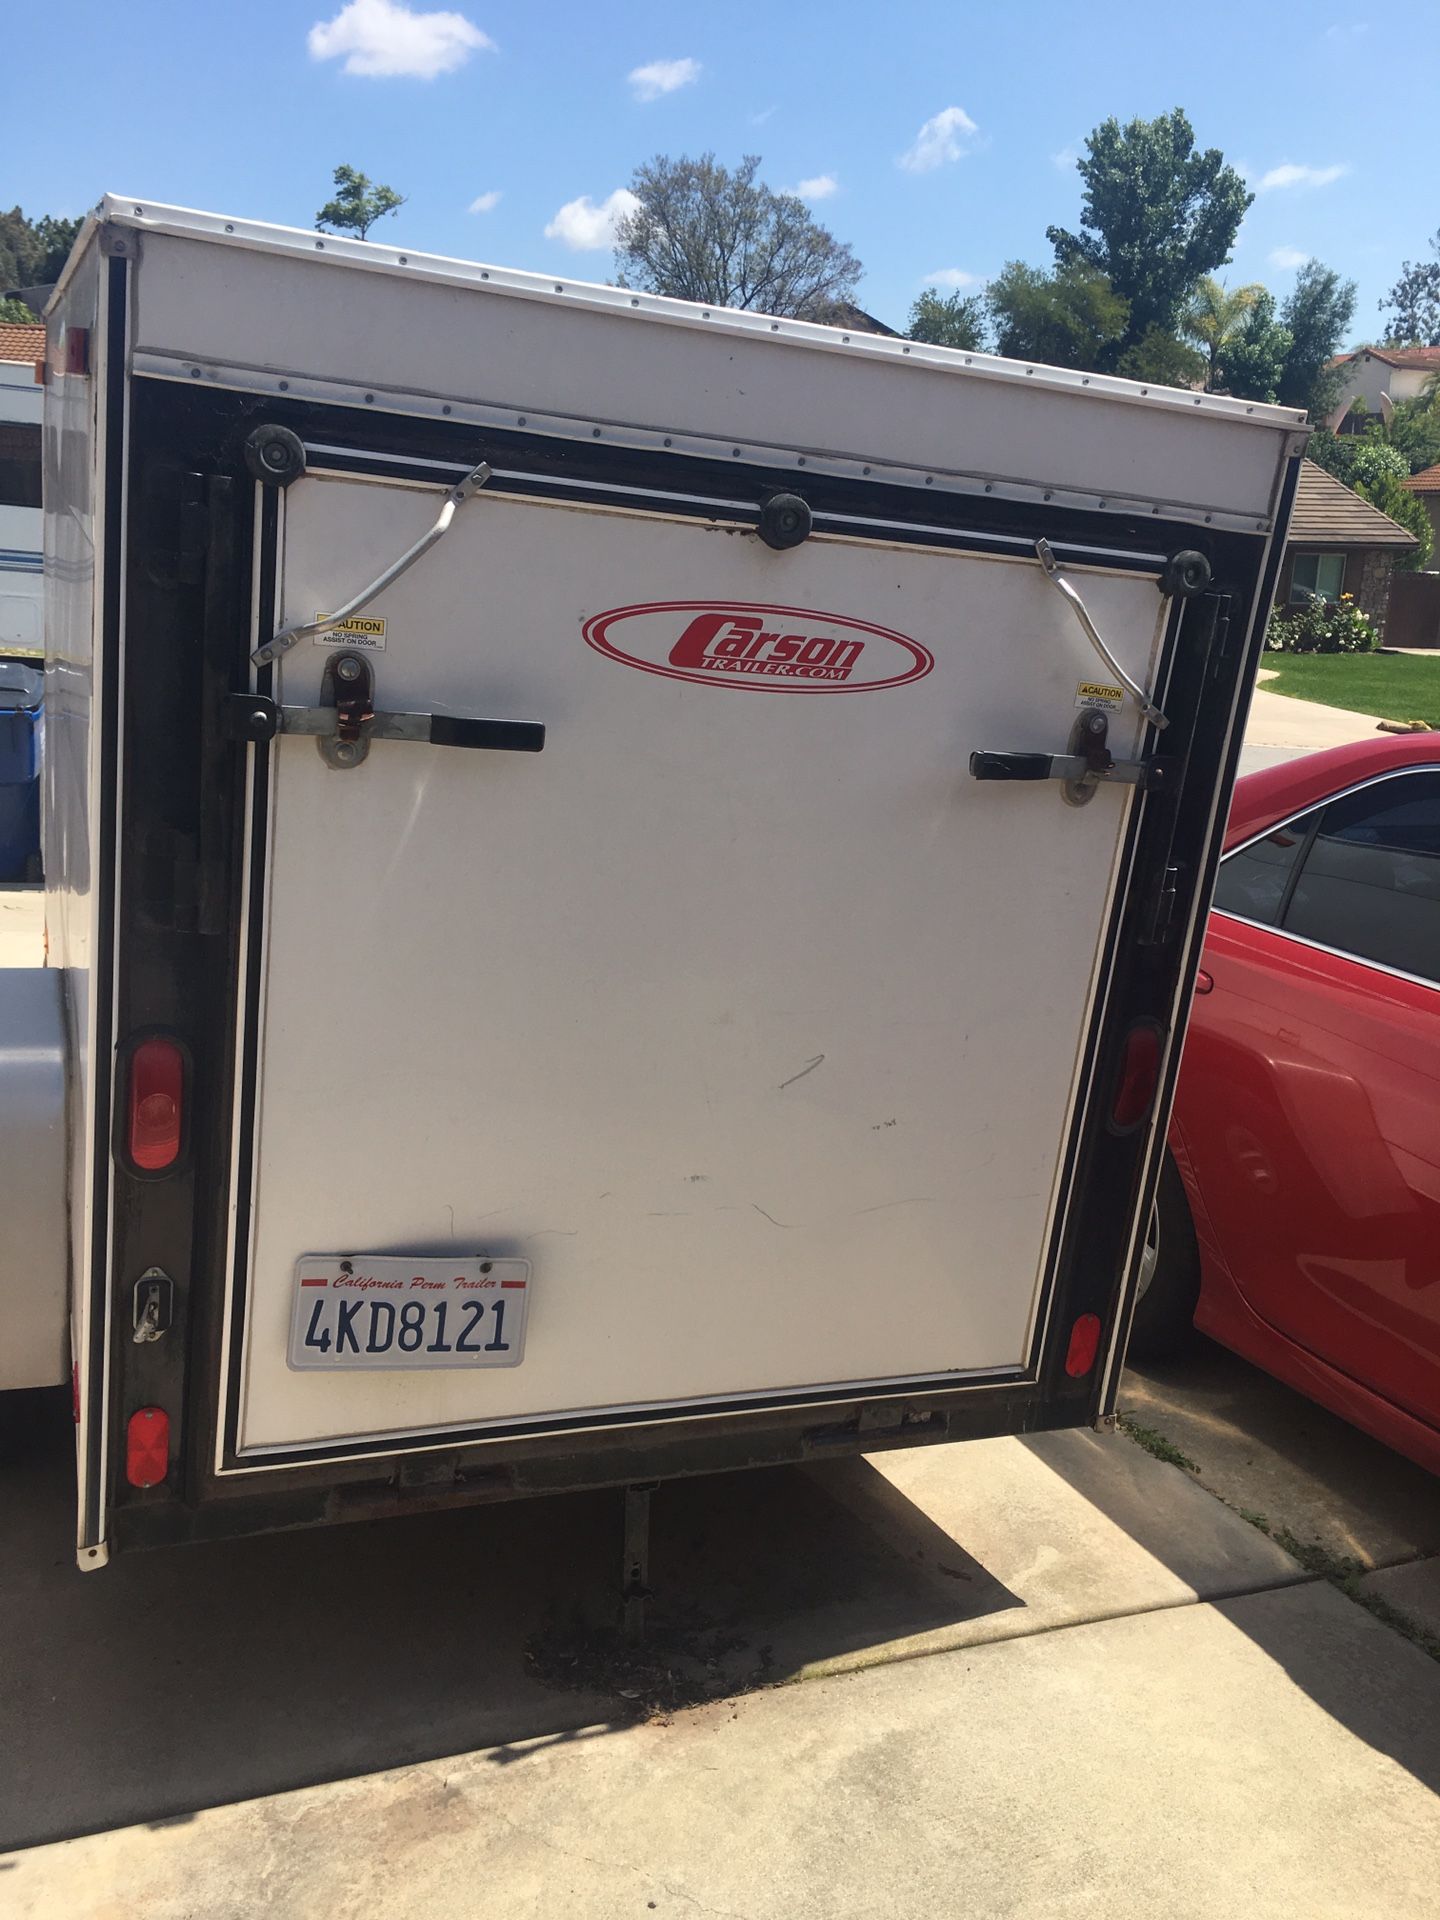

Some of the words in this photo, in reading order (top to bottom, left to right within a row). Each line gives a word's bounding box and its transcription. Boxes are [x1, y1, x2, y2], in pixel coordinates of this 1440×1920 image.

[337, 619, 381, 632] AUTION
[323, 636, 346, 644] ASSIST
[357, 639, 377, 647] DOOR
[343, 632, 368, 640] SPRING
[667, 613, 865, 669] Carson
[699, 656, 847, 681] TRAILER.COM
[1088, 686, 1122, 698] CAUTION
[332, 1274, 404, 1291] California
[409, 1277, 447, 1290] Perm
[453, 1277, 497, 1290] Trailer
[304, 1299, 510, 1353] 4KD8121
